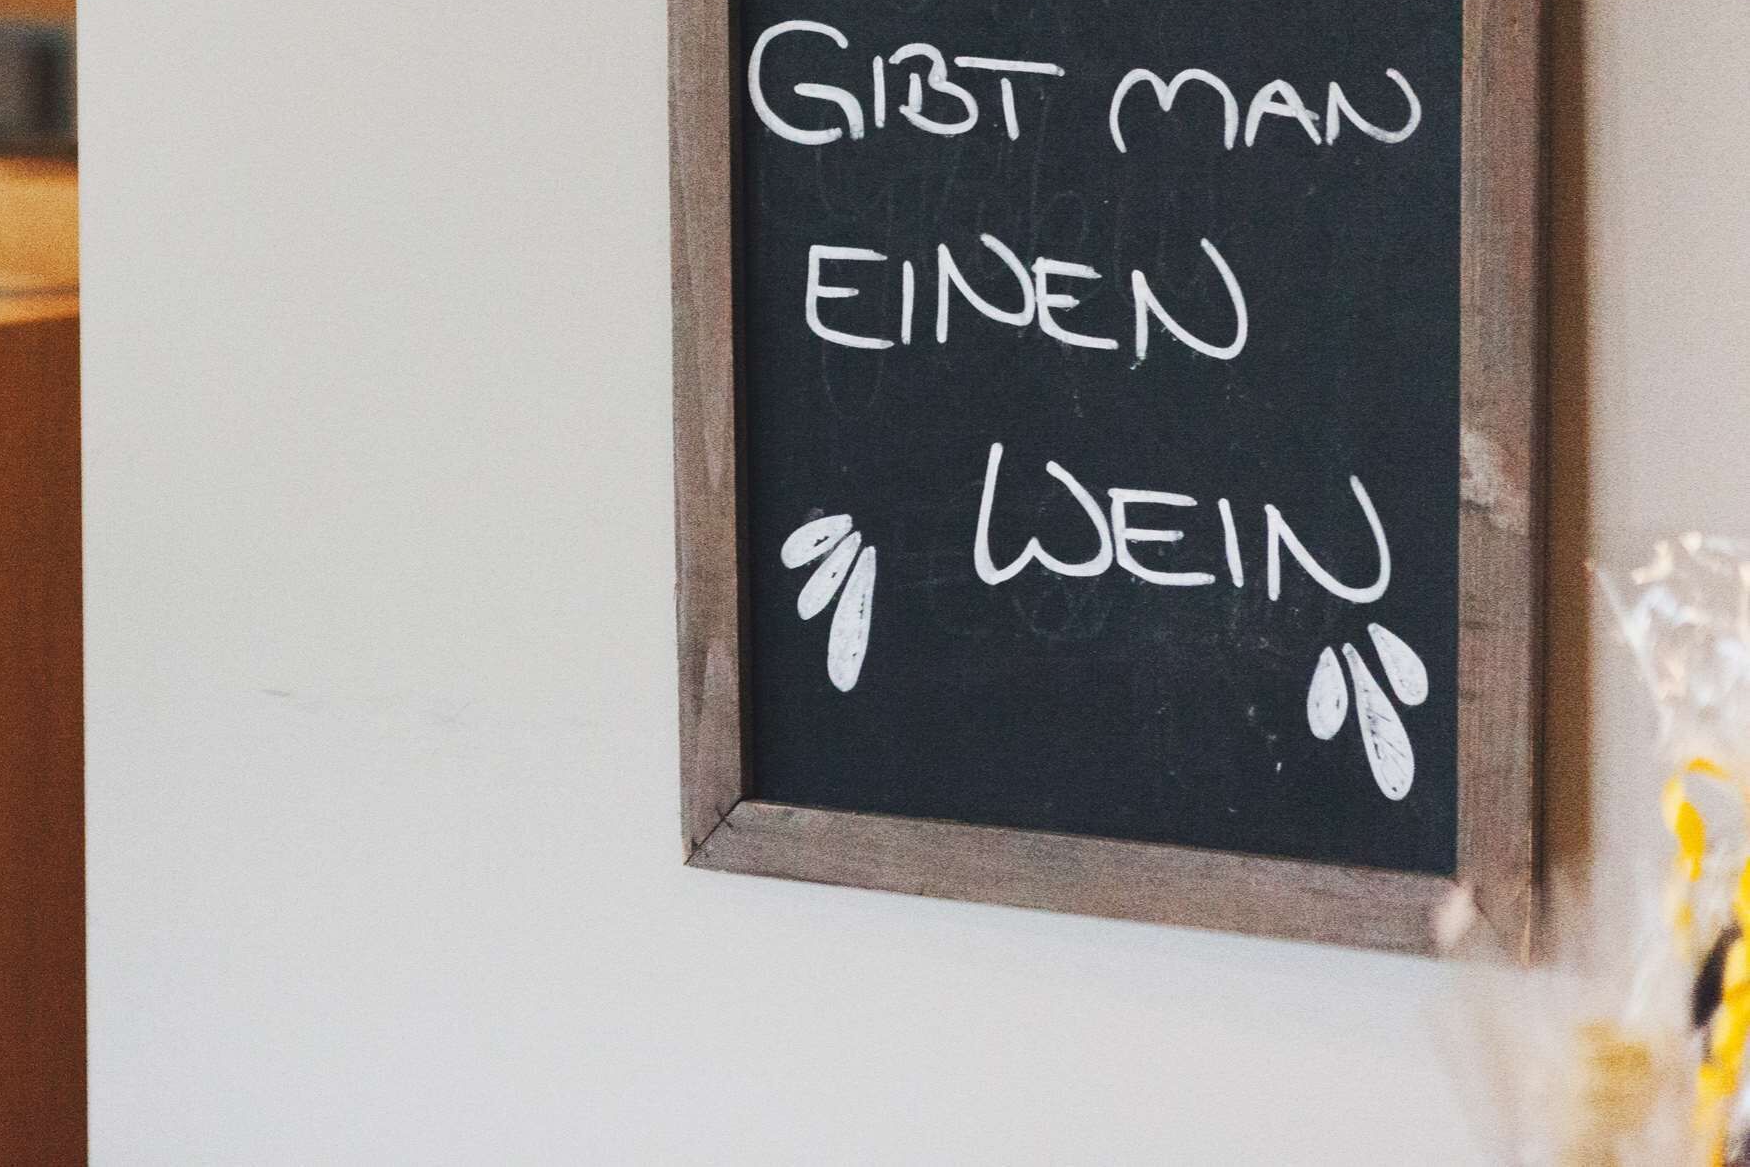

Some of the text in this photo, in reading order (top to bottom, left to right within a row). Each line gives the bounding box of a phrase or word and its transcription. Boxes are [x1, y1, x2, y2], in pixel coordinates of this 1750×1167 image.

[747, 19, 1422, 154] GIBT MAN
[804, 232, 1249, 361] EINEN
[973, 442, 1392, 604] WEIN
